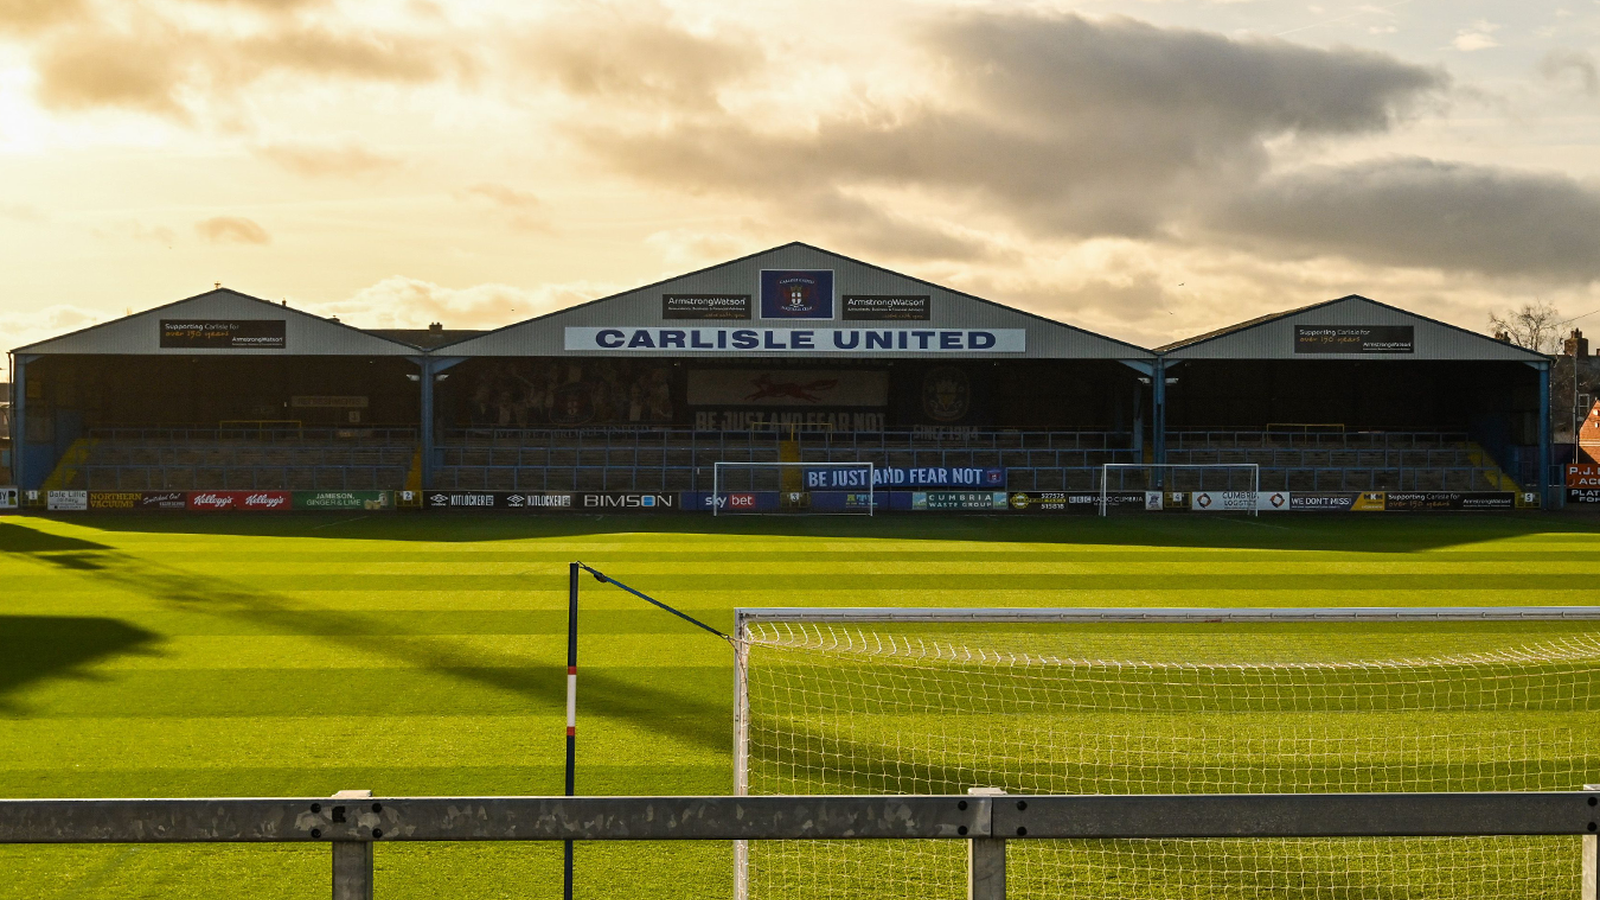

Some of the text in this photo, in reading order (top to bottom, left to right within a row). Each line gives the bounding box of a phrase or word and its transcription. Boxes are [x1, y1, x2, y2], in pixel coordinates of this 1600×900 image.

[667, 297, 746, 306] ArmstrongWatson
[847, 298, 925, 307] ArmstrongWatson
[596, 330, 996, 350] CARLISLE UNITED
[696, 411, 885, 432] BE JUST AND FEAR NOT
[913, 425, 945, 440] SINCE
[1569, 467, 1594, 475] P.J.
[808, 468, 983, 487] BE JUST AND FEAR NOT
[90, 500, 134, 508] VACUUMS
[194, 494, 233, 507] Kellogg's
[246, 494, 285, 507] Kellogg's
[451, 495, 485, 506] KITLOCKER
[527, 495, 561, 506] KITLOCKER
[584, 495, 672, 507] BIMSON
[705, 495, 753, 507] sky bet
